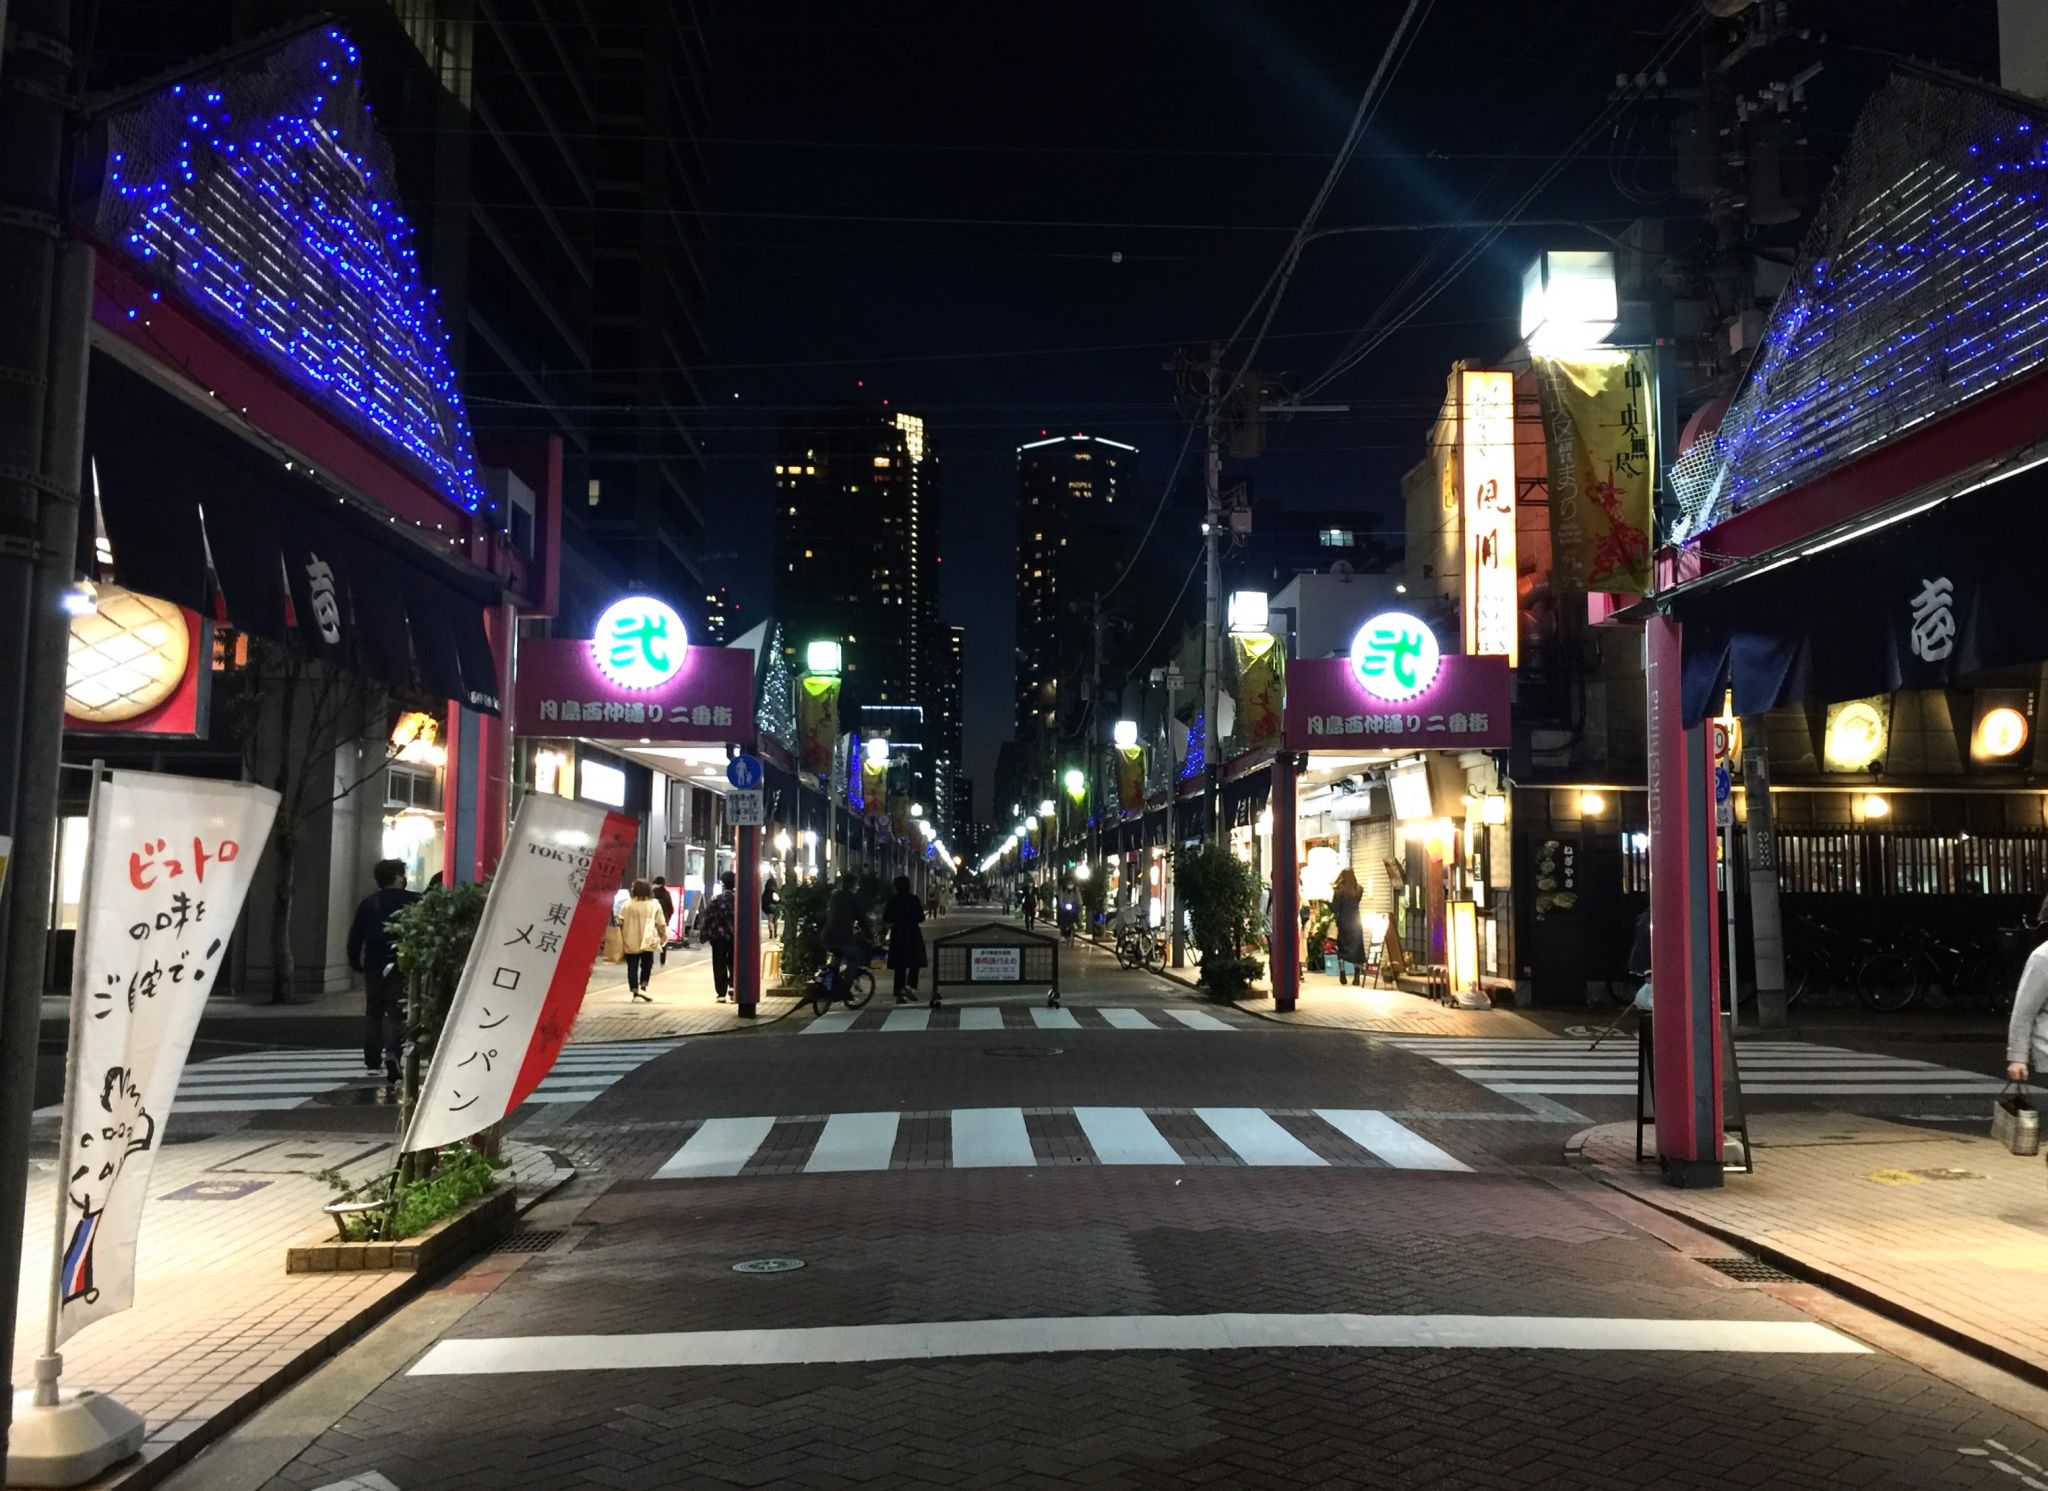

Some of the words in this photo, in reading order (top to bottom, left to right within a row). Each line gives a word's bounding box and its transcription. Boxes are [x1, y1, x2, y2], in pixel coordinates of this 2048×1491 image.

[609, 612, 671, 672] 弐
[1909, 575, 1956, 662] 壱
[1361, 628, 1423, 689] 弐
[127, 836, 240, 891] ビストロ
[528, 842, 590, 869] TOKYO
[1563, 845, 1575, 889] ねぎやき
[128, 891, 207, 941] の味を
[534, 902, 573, 954] 東京
[448, 924, 532, 1113] メロンパン
